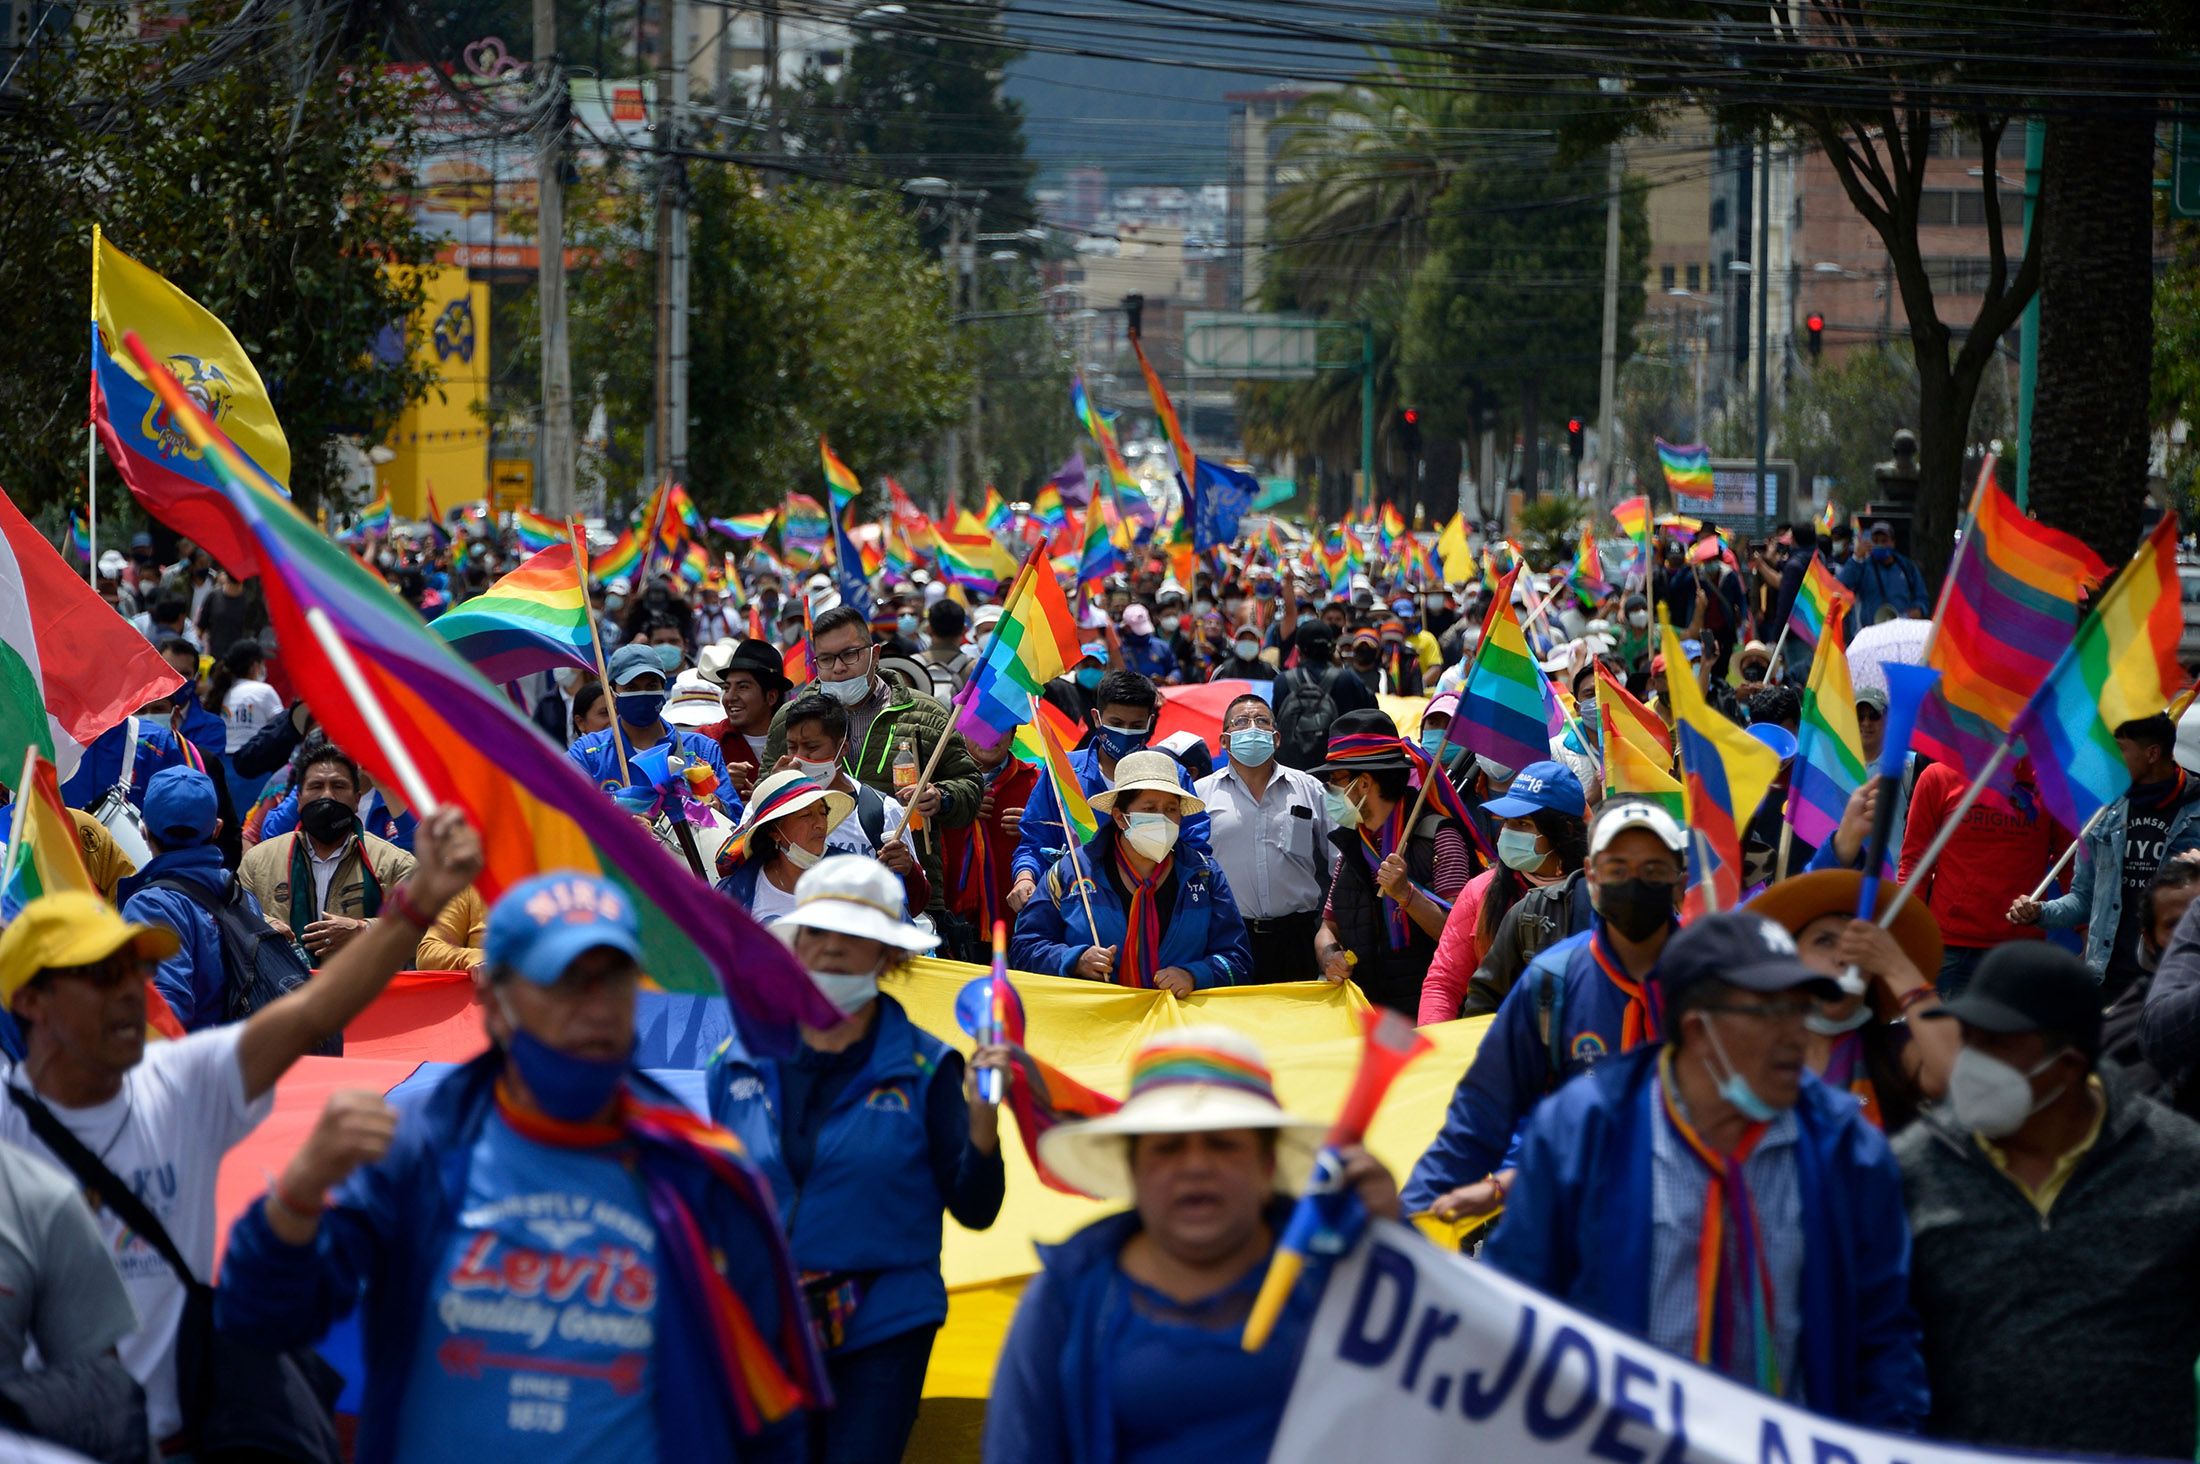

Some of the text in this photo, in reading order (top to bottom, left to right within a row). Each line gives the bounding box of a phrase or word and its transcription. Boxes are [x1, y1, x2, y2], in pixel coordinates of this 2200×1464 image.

[1105, 739, 1120, 754] YAKU
[1527, 777, 1543, 793] 18
[1962, 808, 2040, 832] ORIGINAL
[830, 841, 873, 857] YAK
[133, 1161, 177, 1200] KU
[449, 1231, 657, 1314] Levi's
